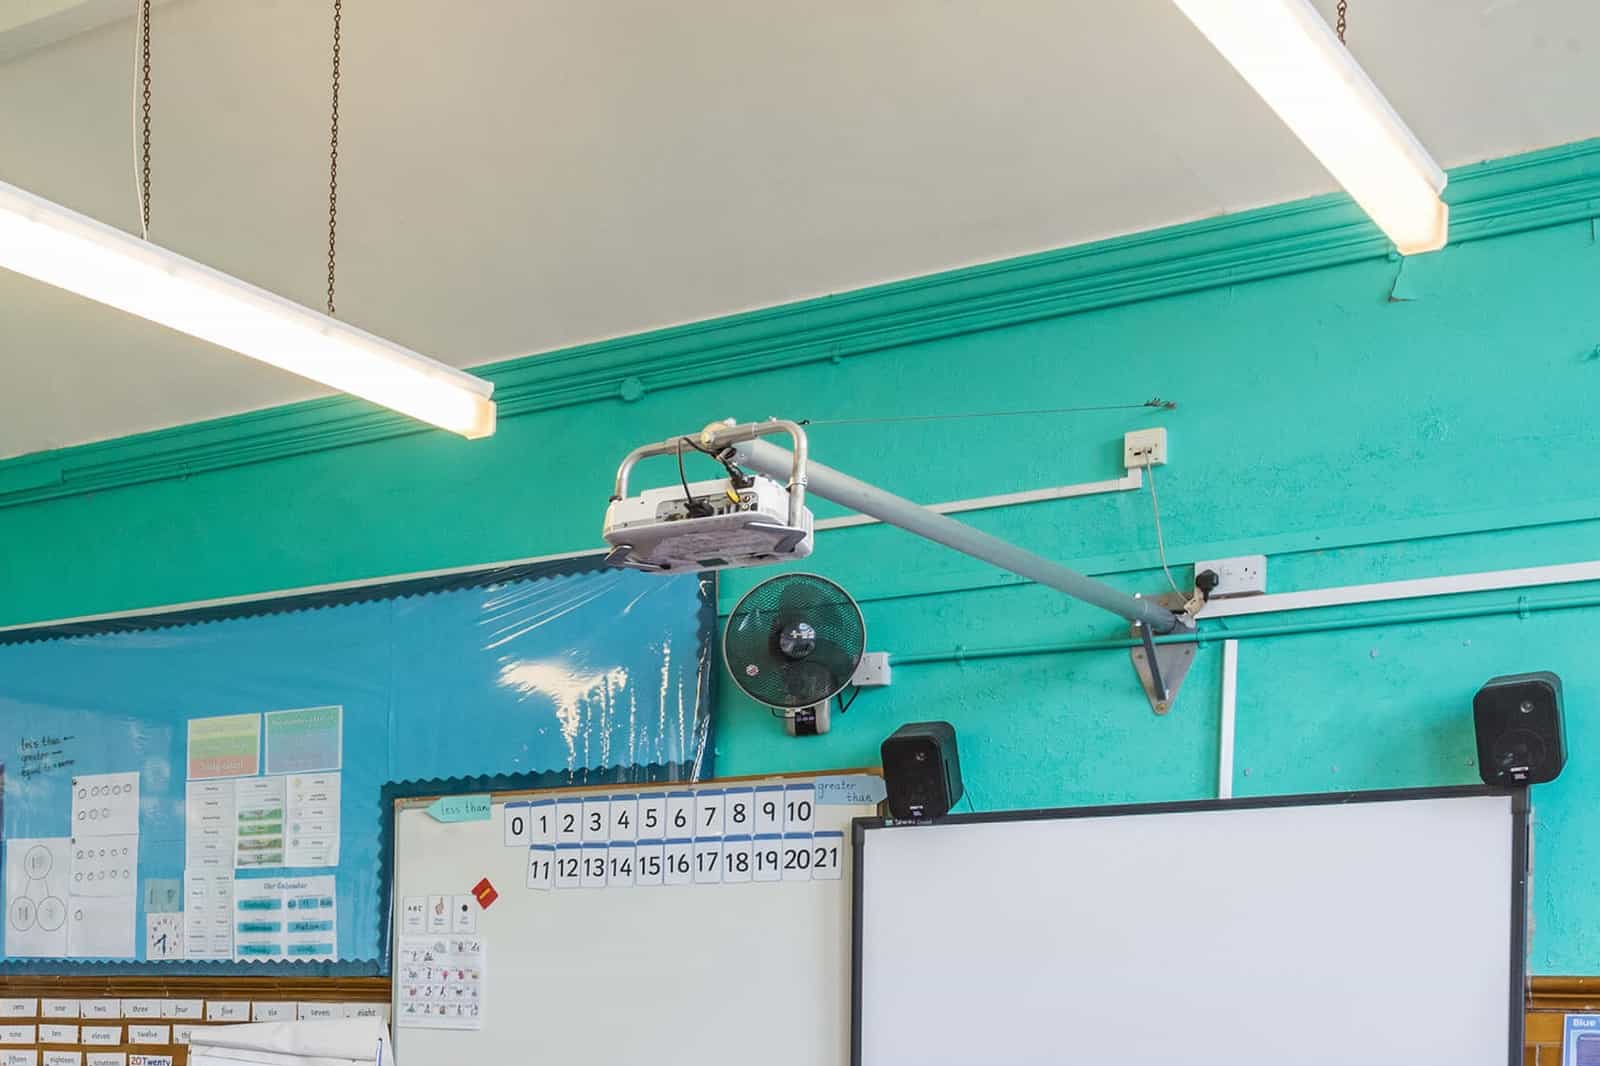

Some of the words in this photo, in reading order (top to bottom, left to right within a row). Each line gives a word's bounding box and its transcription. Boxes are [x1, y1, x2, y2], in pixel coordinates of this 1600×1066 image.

[818, 780, 857, 799] greater
[848, 792, 873, 802] than
[441, 802, 460, 814] less
[465, 800, 490, 812] than
[512, 817, 524, 836] 0
[540, 816, 546, 834] 1
[563, 814, 575, 832] 2
[590, 812, 601, 831] 3
[618, 810, 630, 829] 4
[646, 808, 658, 828] 5
[674, 808, 686, 828] 6
[704, 807, 716, 826] 7
[733, 804, 746, 823] 8
[762, 802, 776, 822] 9
[787, 801, 812, 822] 10
[531, 861, 550, 880] 11
[558, 858, 578, 877] 12
[584, 858, 604, 877] 13
[610, 858, 632, 876] 14
[640, 856, 660, 876] 15
[668, 854, 690, 873] 16
[696, 852, 718, 872] 17
[726, 852, 749, 872] 18
[755, 851, 778, 871] 19
[784, 850, 810, 870] 20
[814, 848, 837, 868] 21
